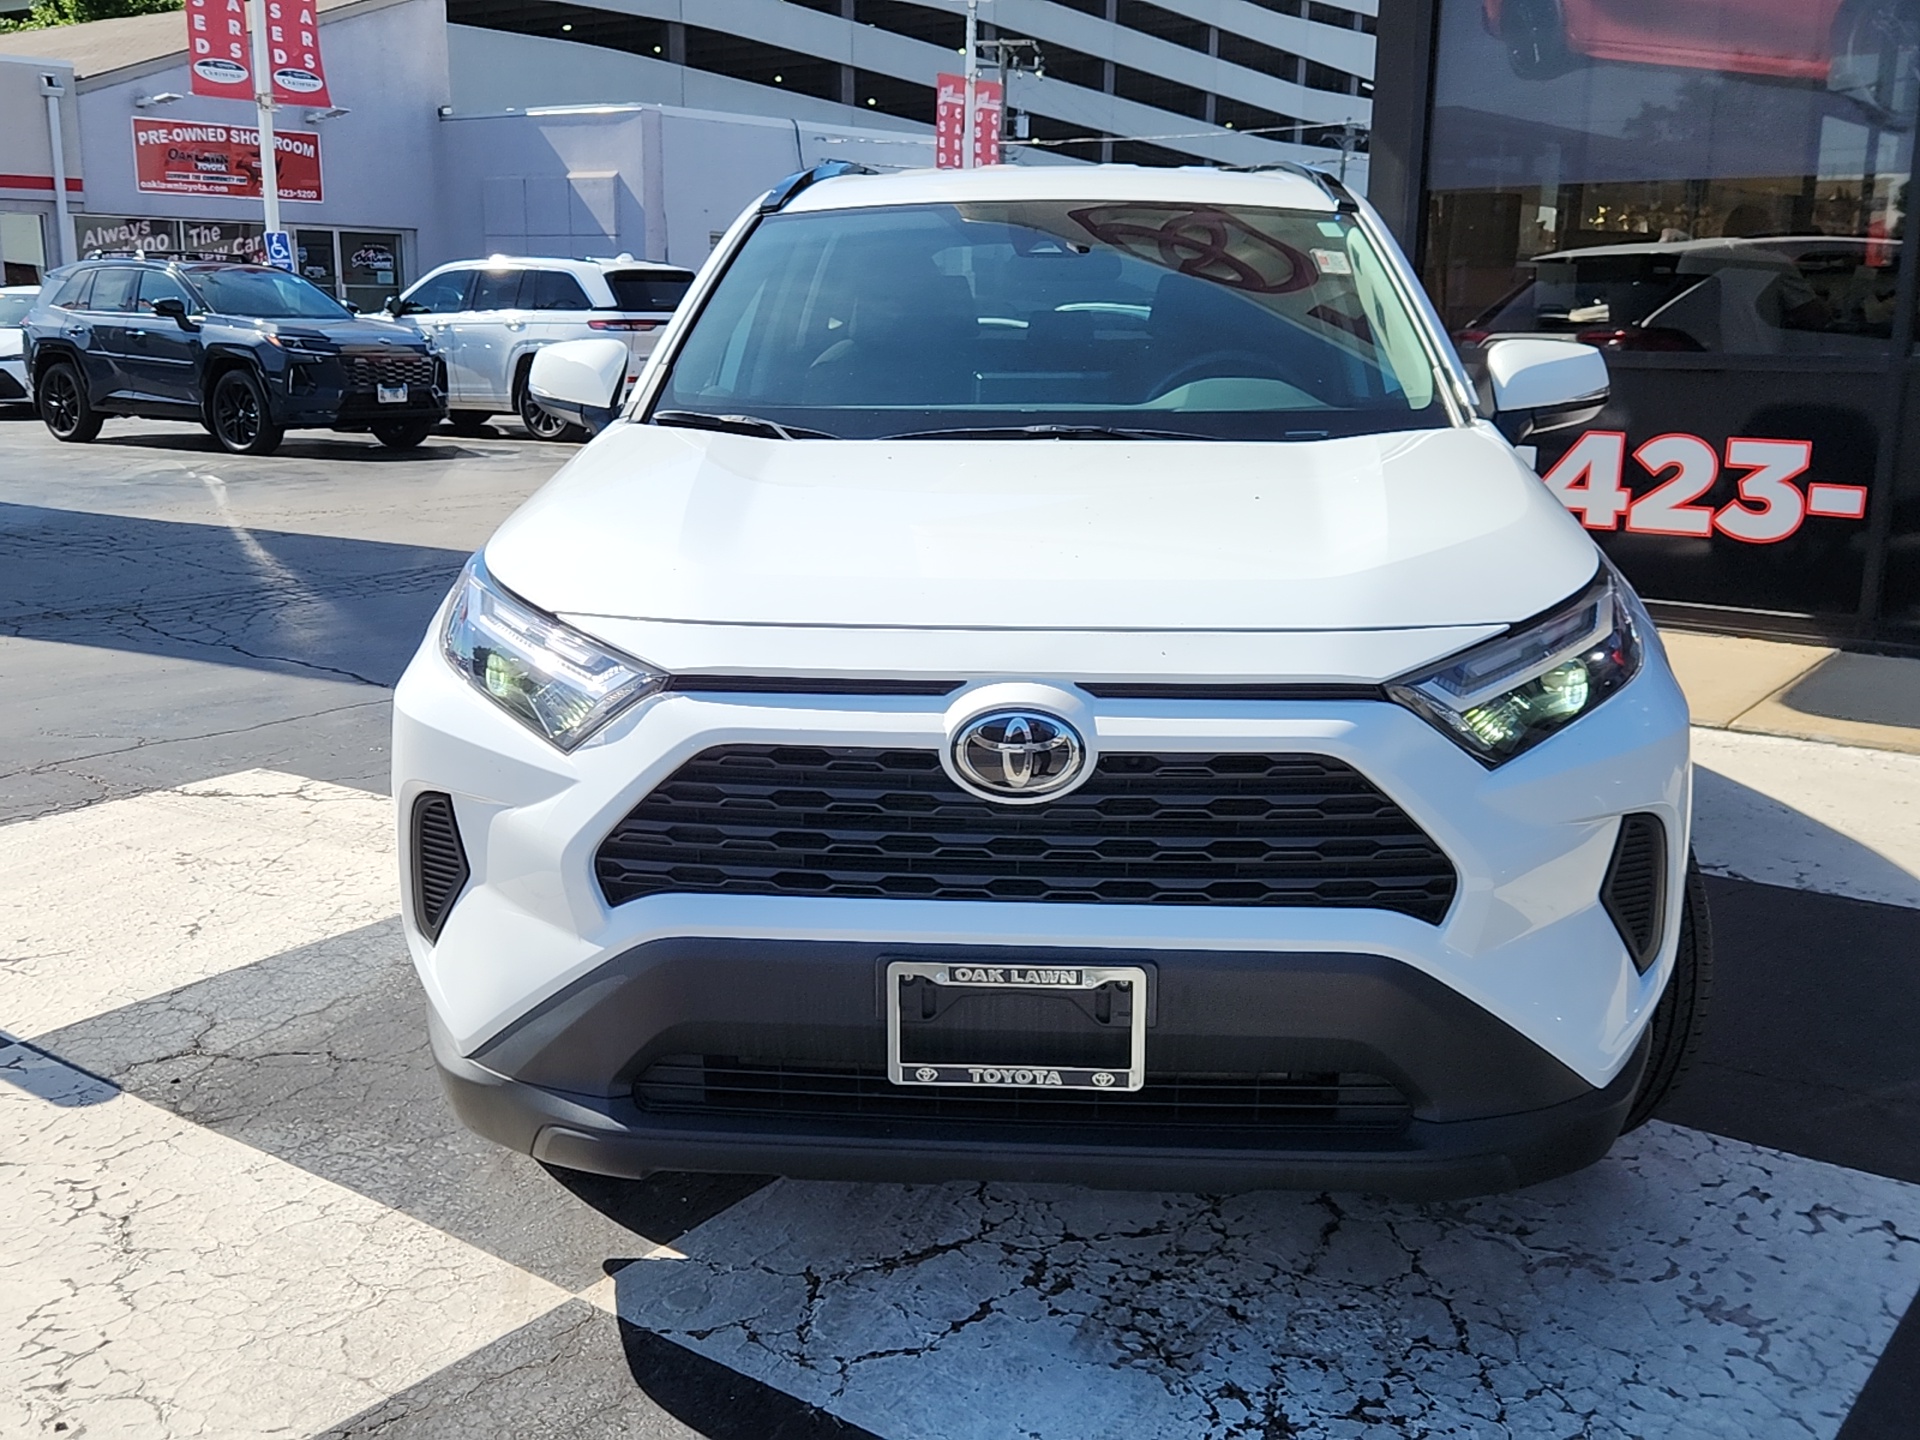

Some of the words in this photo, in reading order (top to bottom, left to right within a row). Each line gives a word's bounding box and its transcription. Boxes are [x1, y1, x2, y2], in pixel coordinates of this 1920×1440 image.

[299, 0, 316, 69] ARS
[137, 127, 228, 146] PRE-OWNED
[229, 130, 315, 158] SHOROOM
[939, 105, 947, 163] USED
[954, 107, 962, 166] CARS
[259, 187, 317, 199] 7-423-5200
[82, 220, 151, 249] Always
[189, 224, 221, 248] The
[232, 235, 262, 256] Car
[955, 967, 1004, 983] OAK
[1009, 969, 1078, 985] LAWN
[967, 1068, 1063, 1085] TOYOTA
